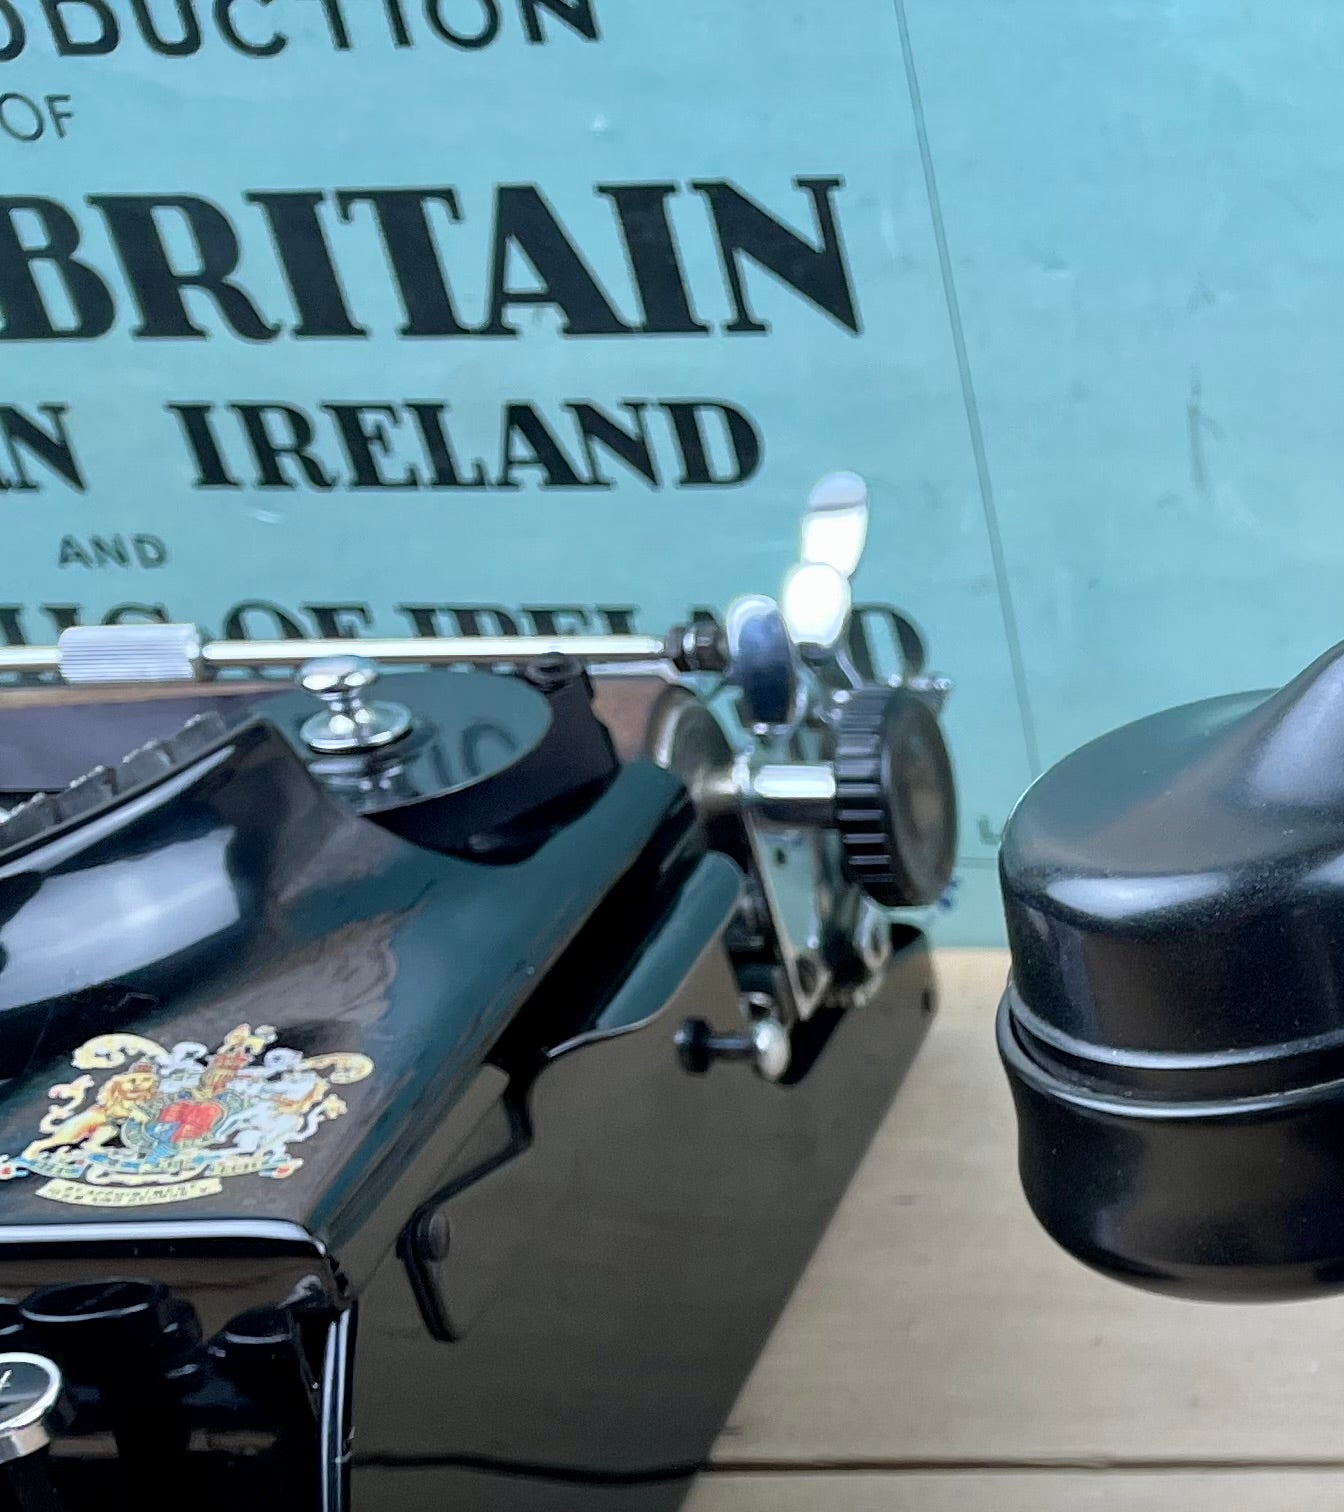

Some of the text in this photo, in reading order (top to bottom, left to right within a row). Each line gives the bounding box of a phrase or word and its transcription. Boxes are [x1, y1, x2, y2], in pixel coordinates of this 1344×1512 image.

[0, 92, 73, 141] OF
[0, 176, 862, 343] BRITAIN
[166, 401, 762, 491] IRELAND
[57, 533, 168, 569] AND
